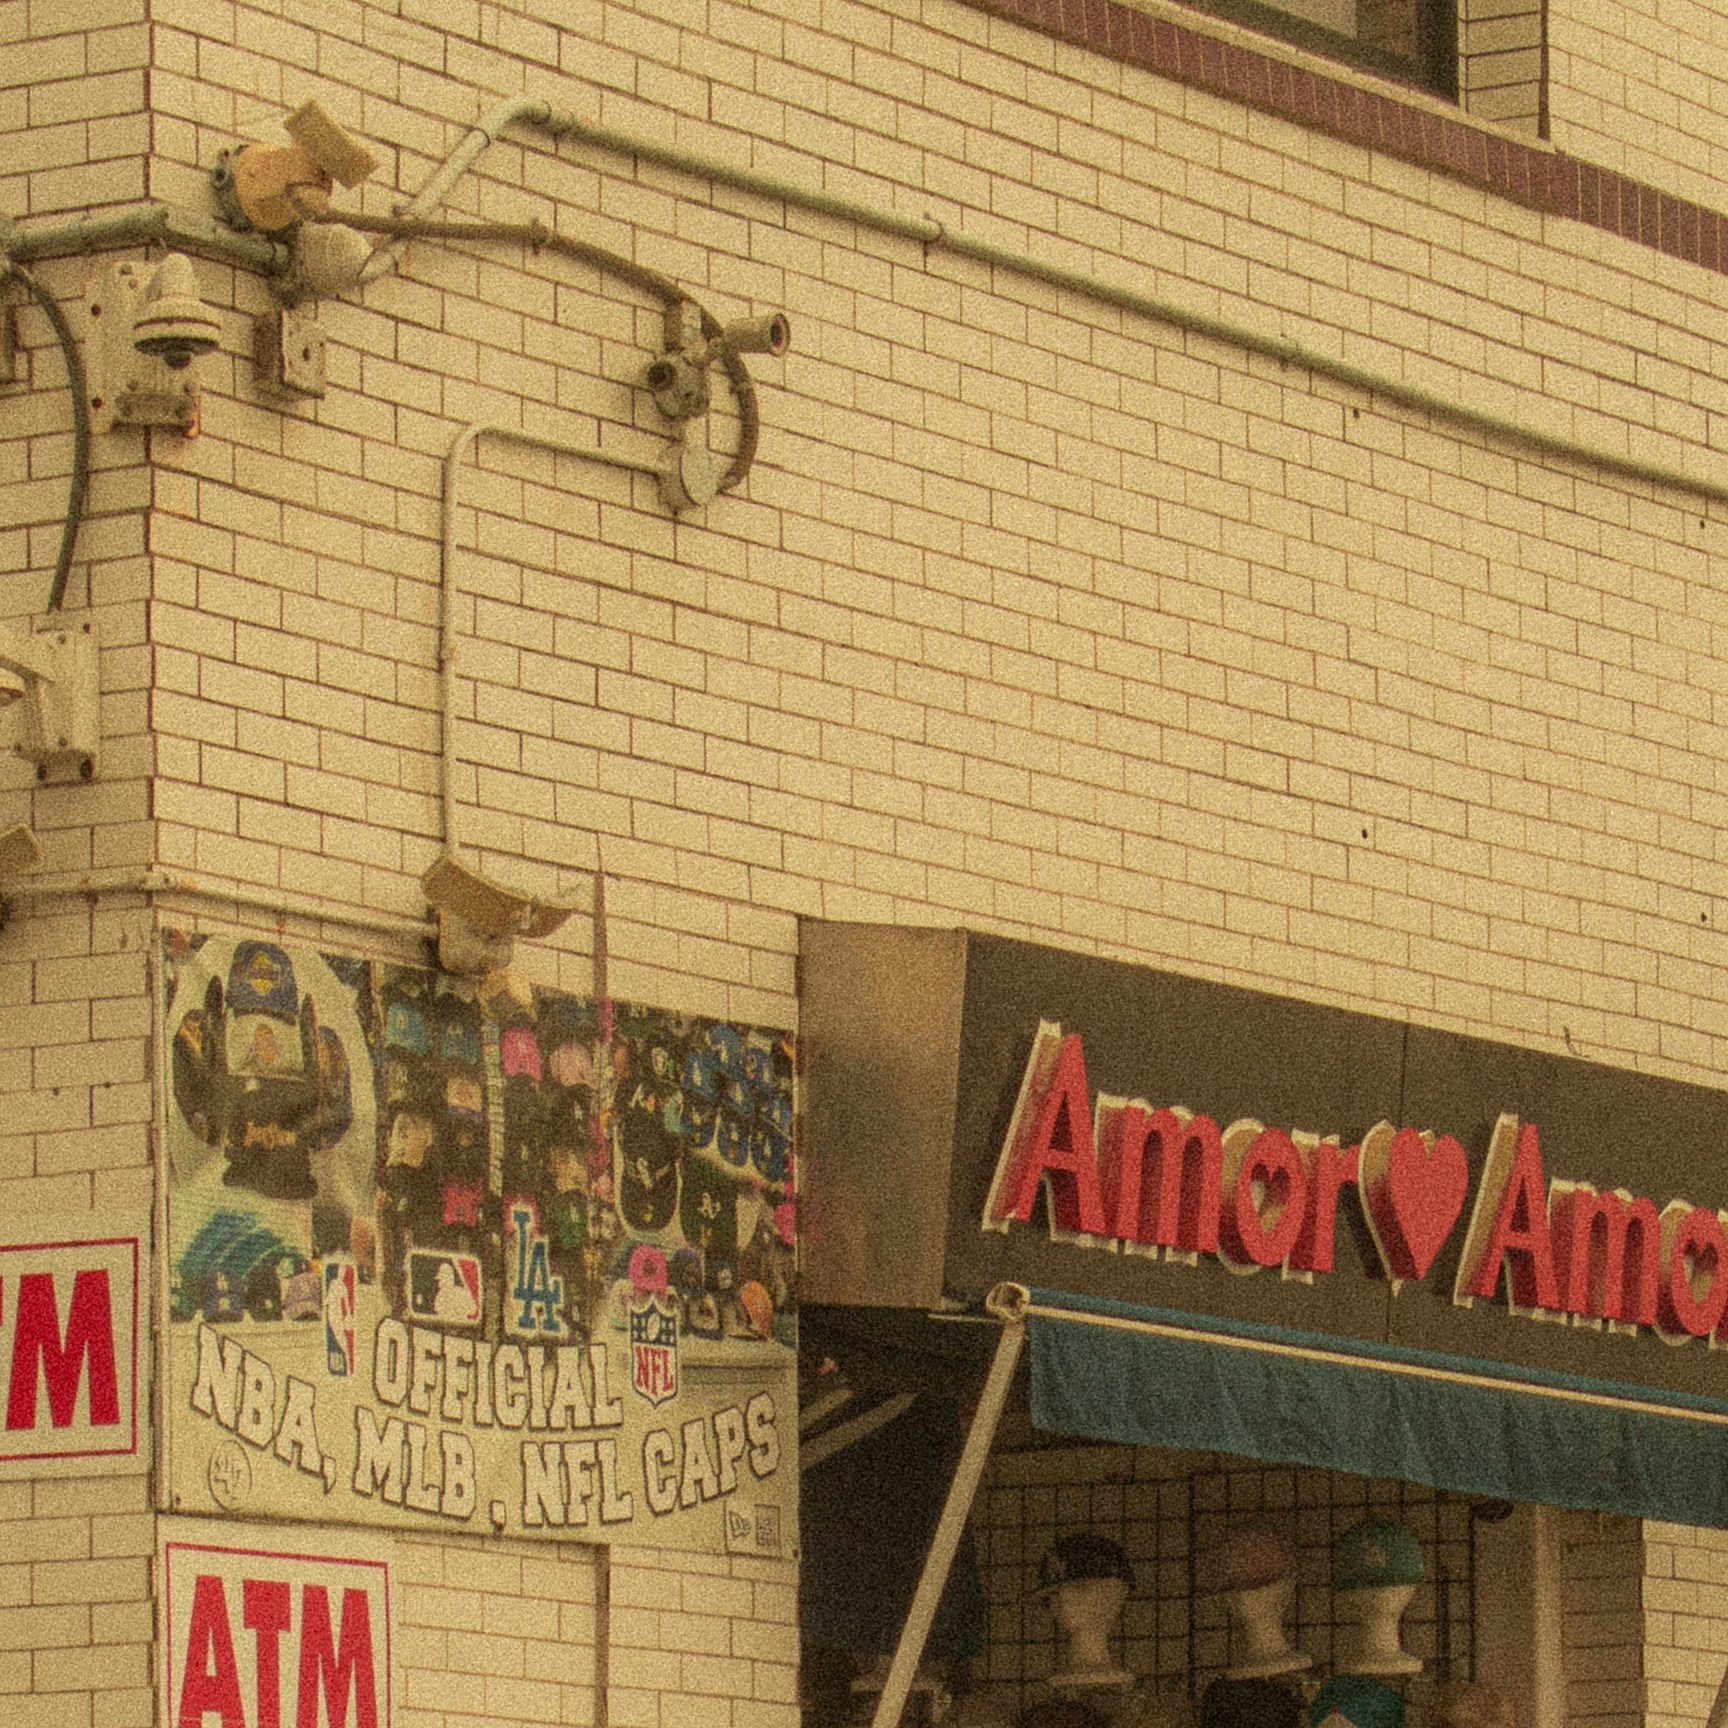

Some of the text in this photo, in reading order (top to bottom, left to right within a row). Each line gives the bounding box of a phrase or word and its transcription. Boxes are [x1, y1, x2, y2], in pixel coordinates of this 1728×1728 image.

[981, 1018, 1364, 1285] Amor
[191, 1322, 337, 1496] NBA,
[521, 1437, 634, 1529] NFL
[643, 1390, 781, 1518] CAPS
[373, 1315, 622, 1430] OFFICIAL
[634, 1345, 674, 1398] NFL
